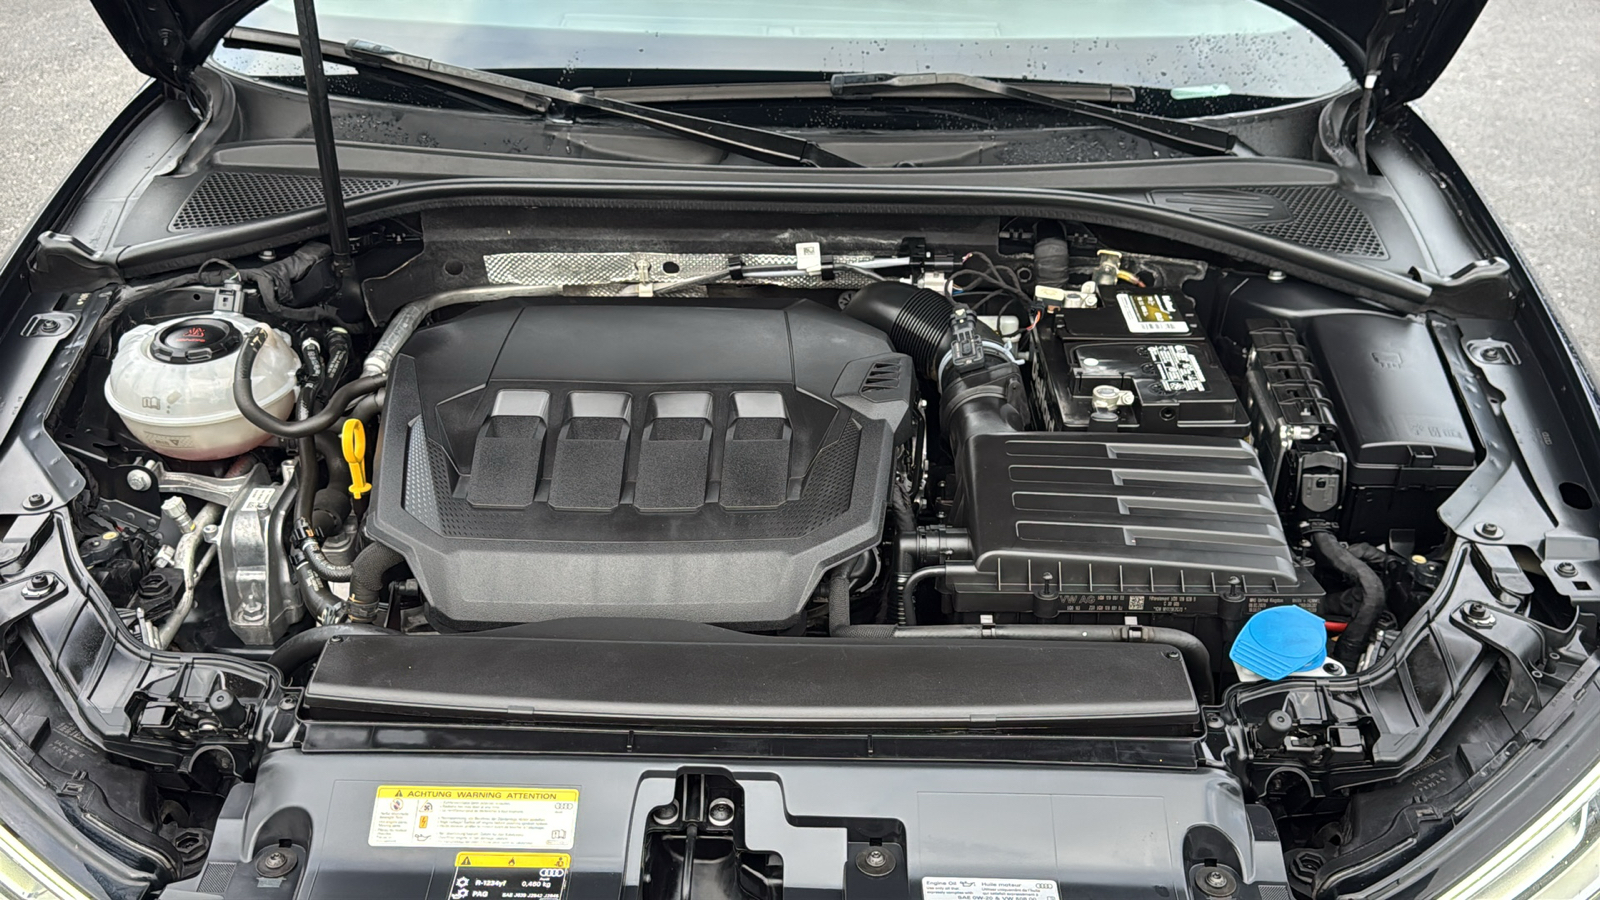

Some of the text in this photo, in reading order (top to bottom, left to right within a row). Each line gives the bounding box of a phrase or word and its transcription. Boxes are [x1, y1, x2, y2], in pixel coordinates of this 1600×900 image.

[407, 790, 557, 800] ACHTUNG WARNING ATTENTION
[542, 881, 551, 889] kg
[472, 890, 489, 898] PAG
